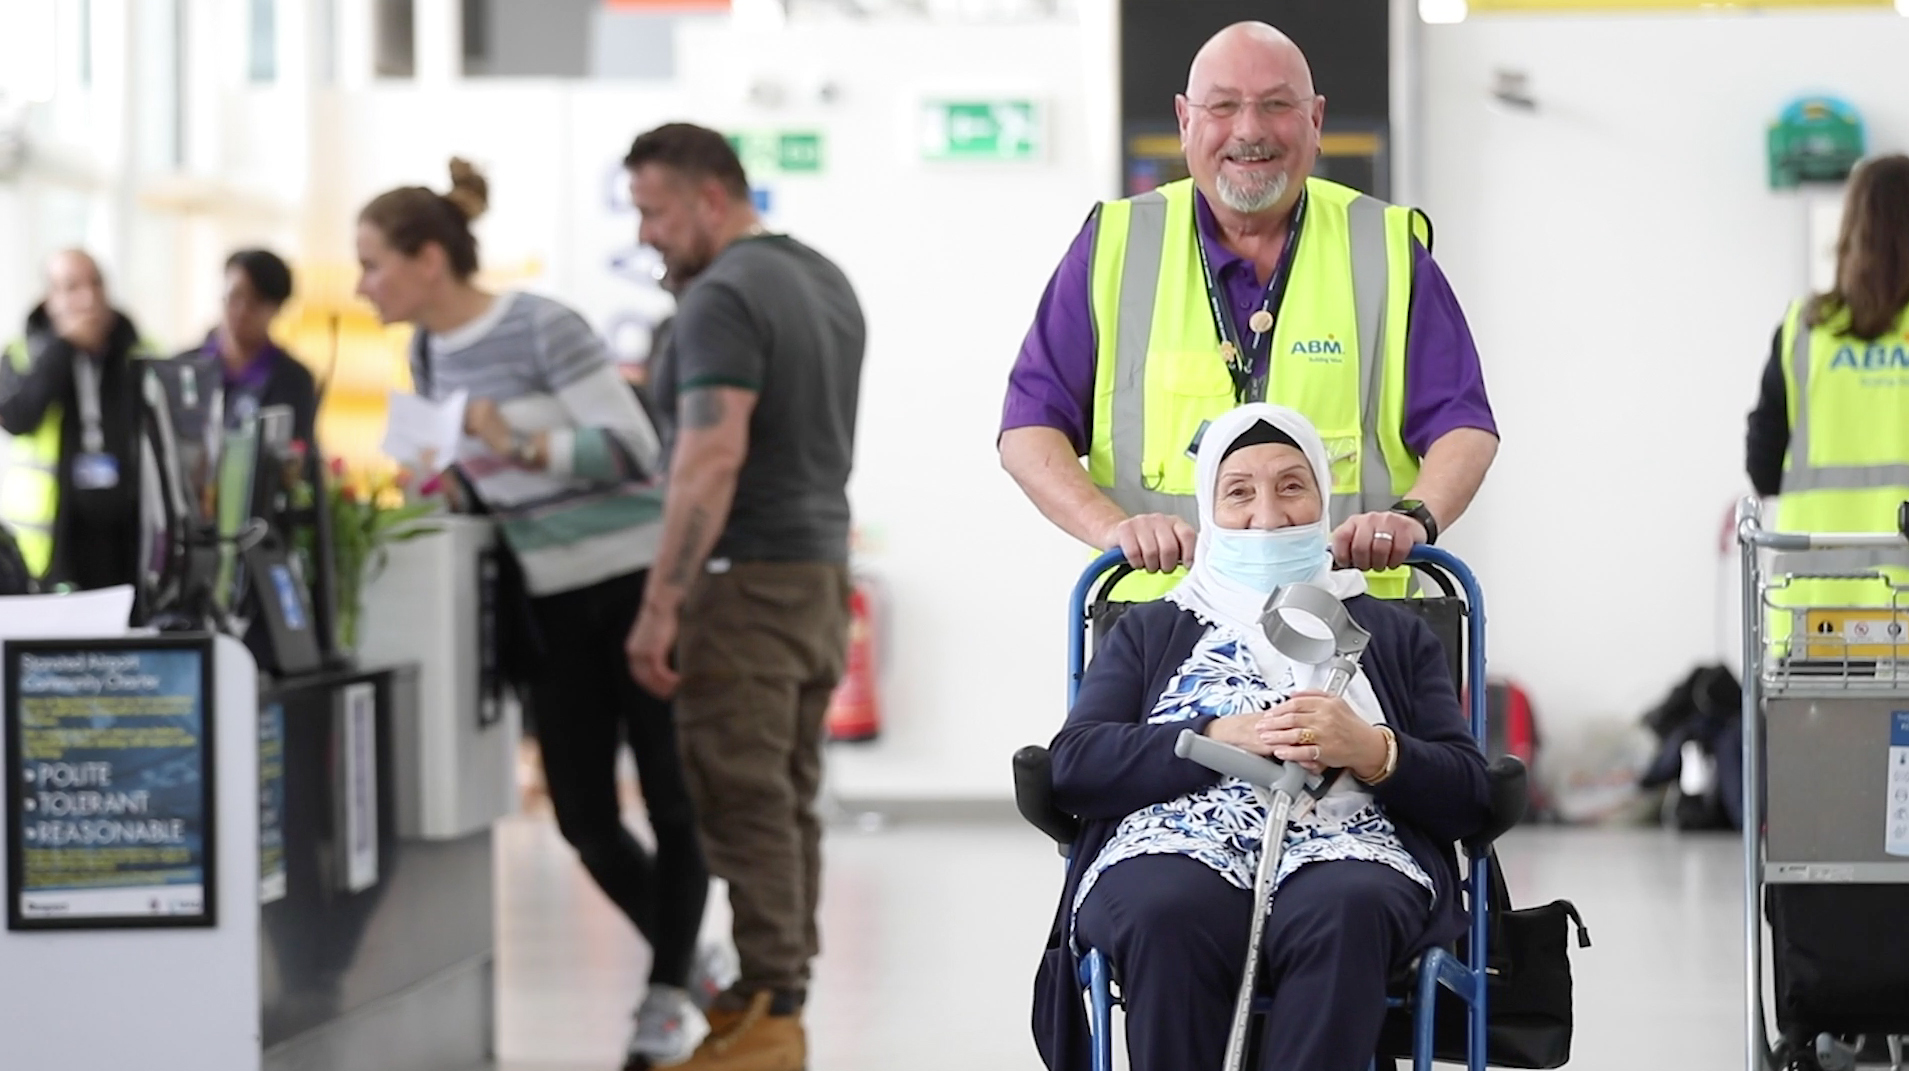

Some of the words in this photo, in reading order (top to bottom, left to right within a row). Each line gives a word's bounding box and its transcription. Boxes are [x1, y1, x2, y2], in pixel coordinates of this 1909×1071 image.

[1291, 340, 1342, 354] ABM
[37, 761, 112, 788] POLITE
[37, 790, 149, 816] TOLERANT
[37, 818, 185, 846] REASONABLE
